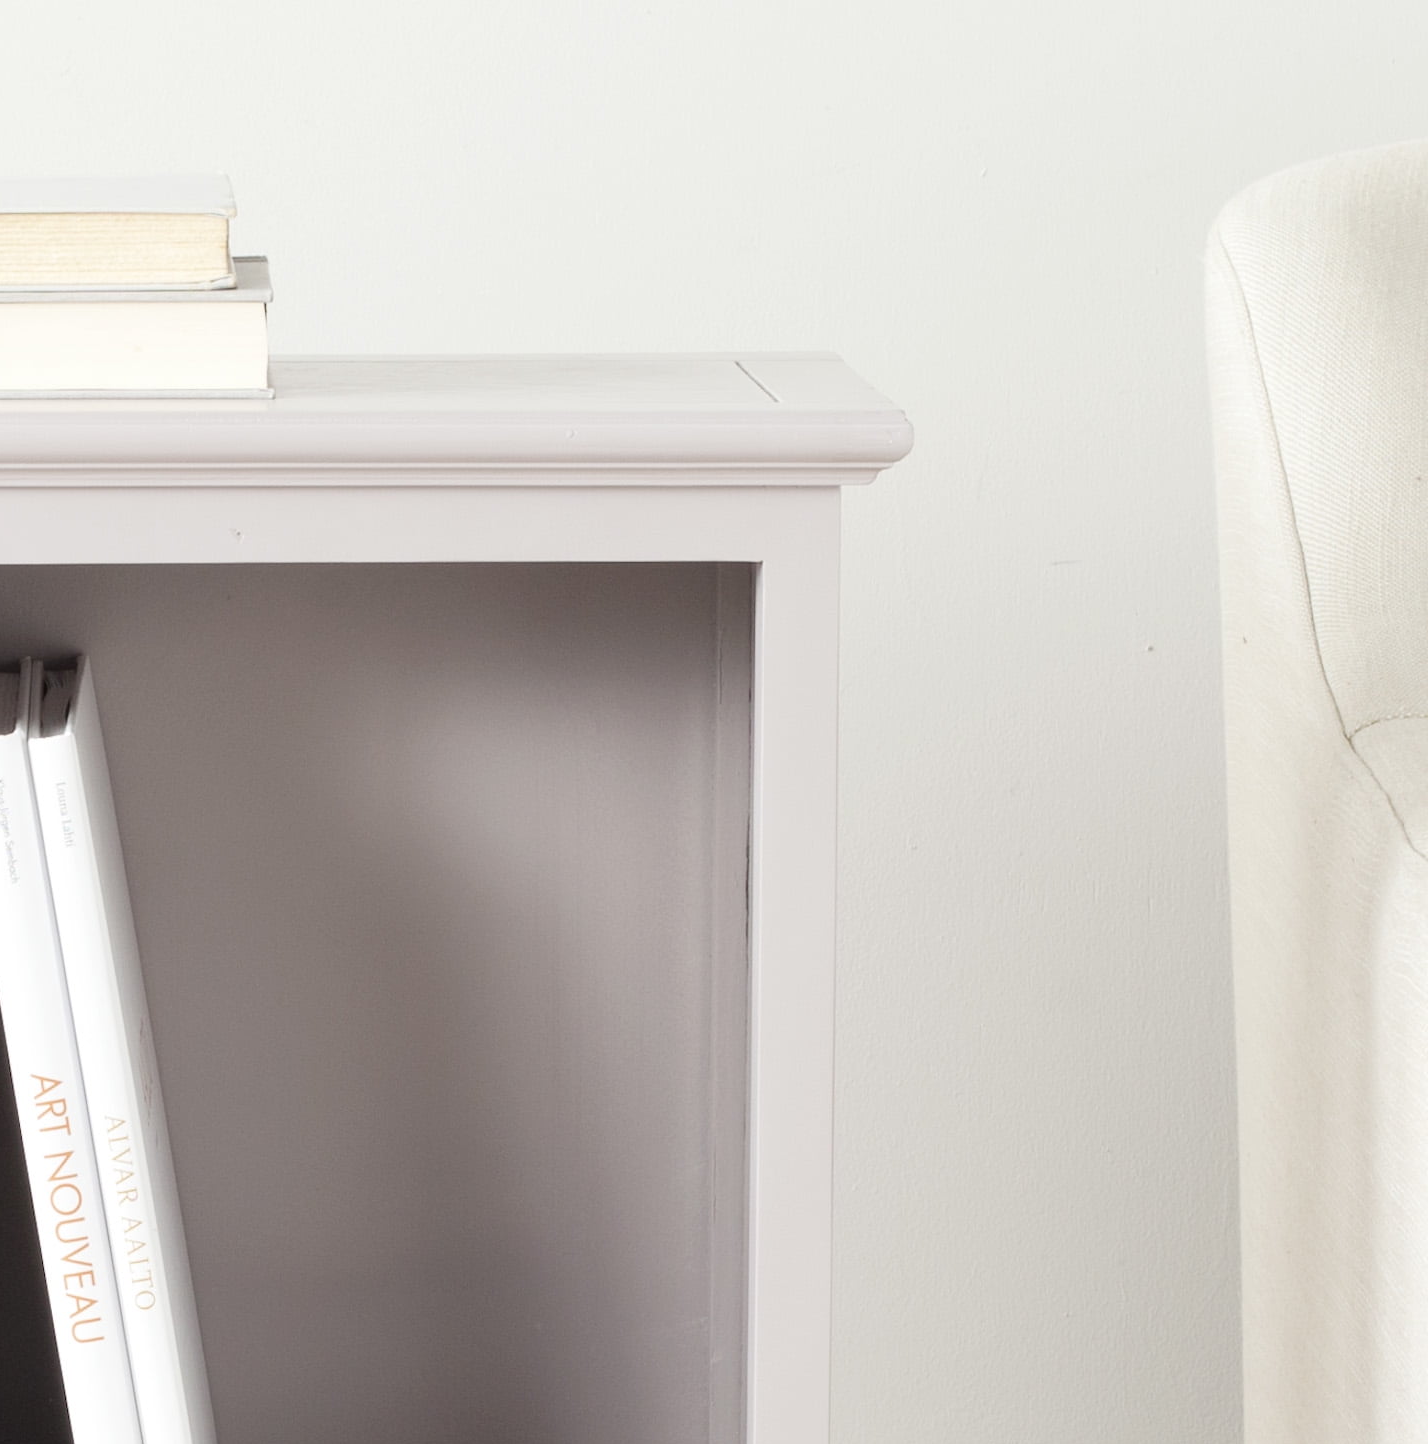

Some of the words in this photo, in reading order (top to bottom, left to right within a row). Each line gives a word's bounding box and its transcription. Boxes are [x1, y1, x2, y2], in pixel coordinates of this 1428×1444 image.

[30, 1073, 71, 1136] ART
[104, 1114, 139, 1206] ALVAR
[43, 1150, 105, 1344] NOUVEAU
[121, 1216, 156, 1311] AALTO
